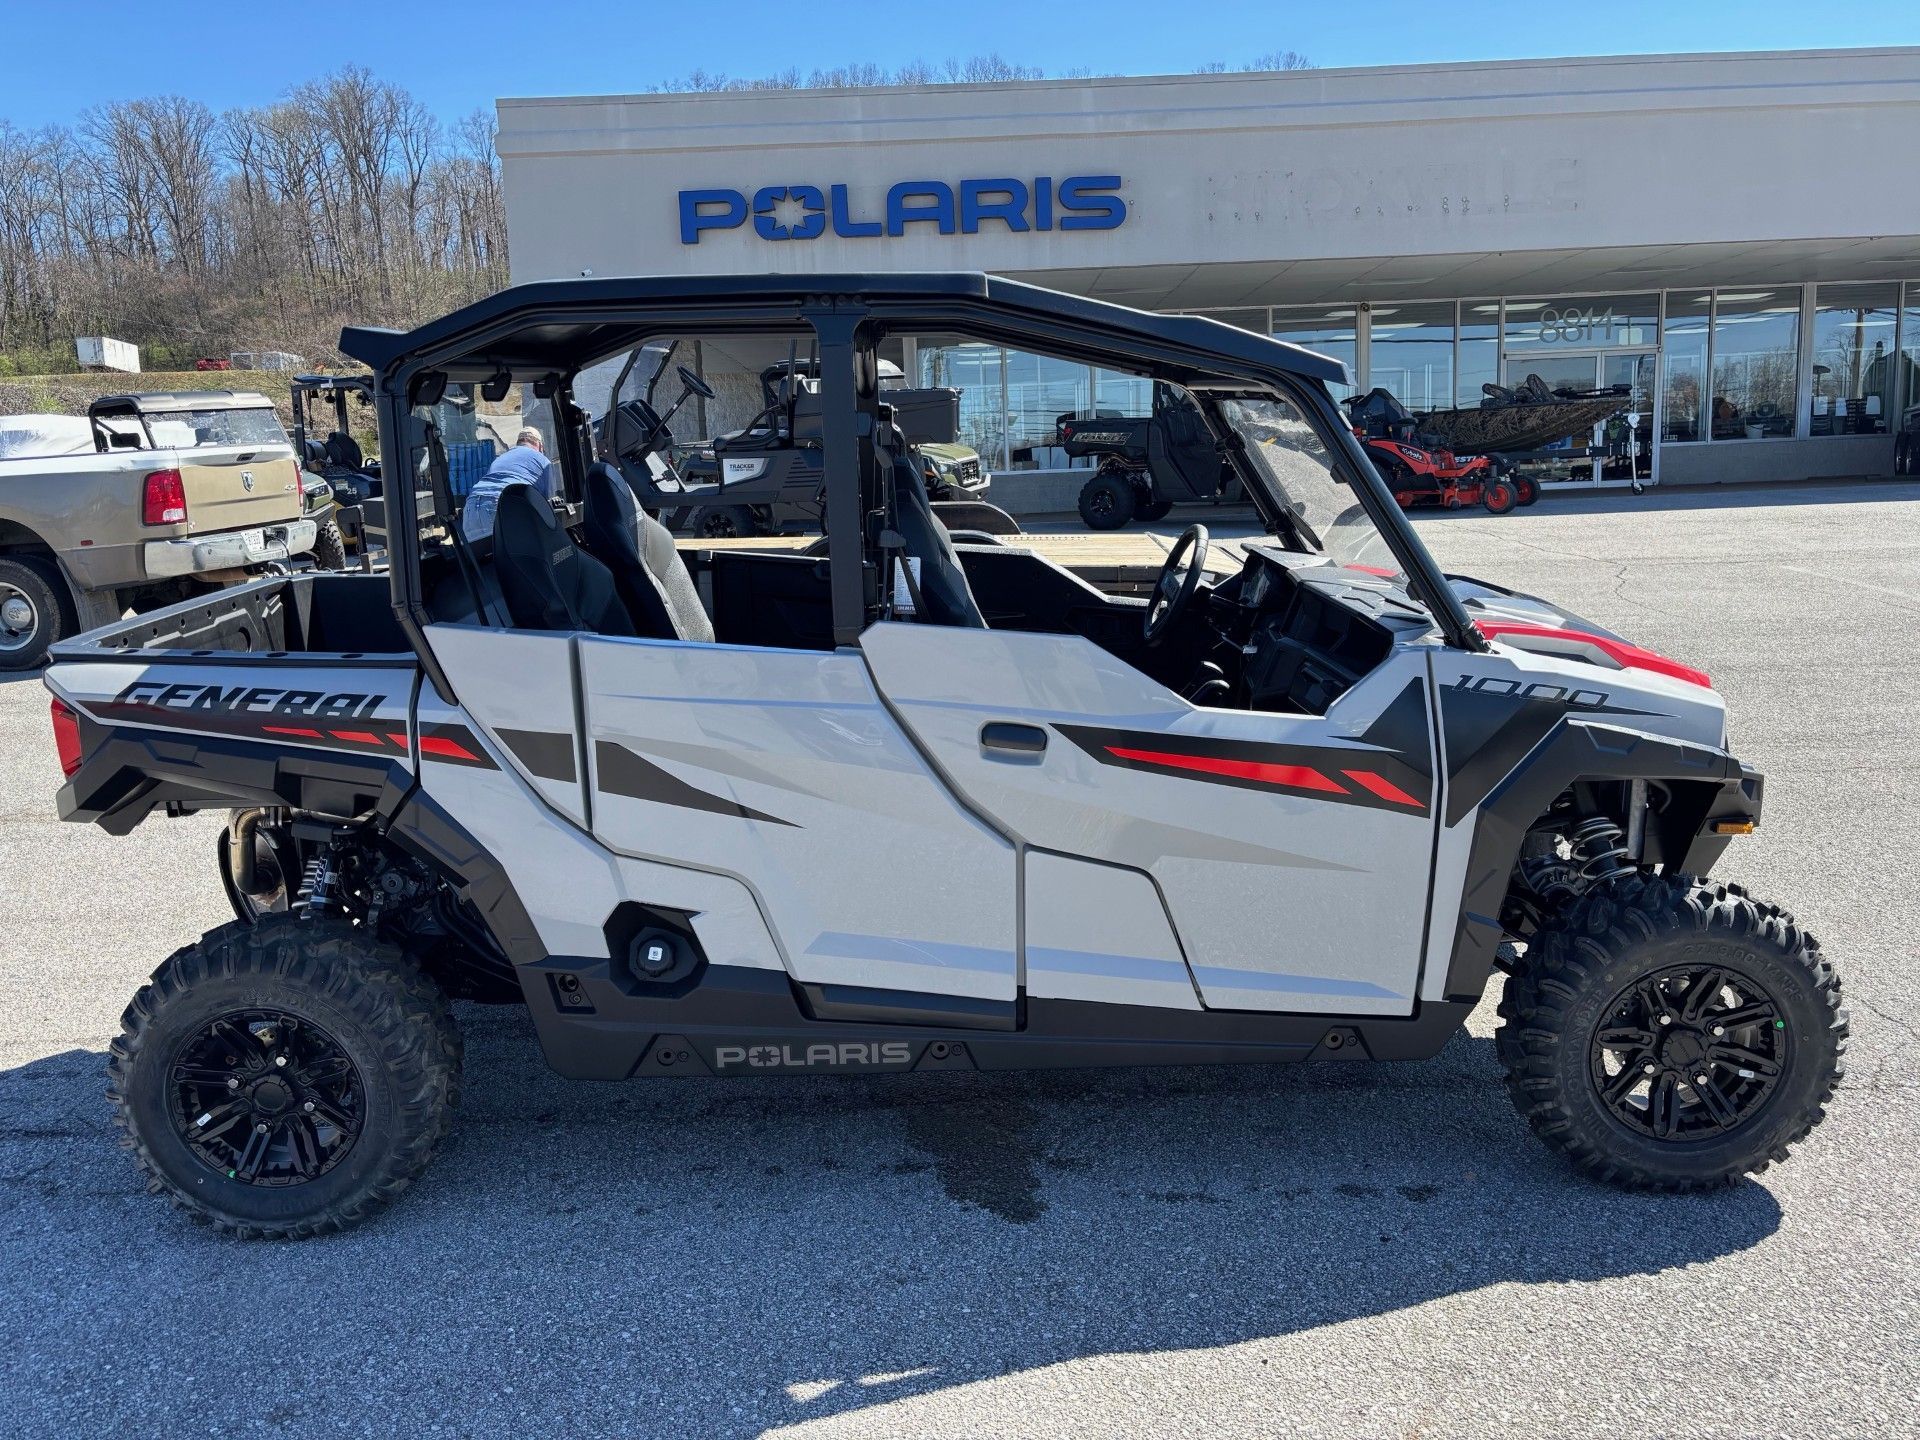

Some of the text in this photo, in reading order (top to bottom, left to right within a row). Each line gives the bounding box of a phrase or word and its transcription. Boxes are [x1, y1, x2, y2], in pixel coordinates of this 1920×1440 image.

[678, 175, 1127, 245] POLARIS
[1540, 305, 1614, 343] 8814
[346, 487, 358, 495] 25
[114, 681, 388, 721] GENERAL
[1451, 674, 1610, 708] 1000
[715, 1042, 912, 1068] POLARIS
